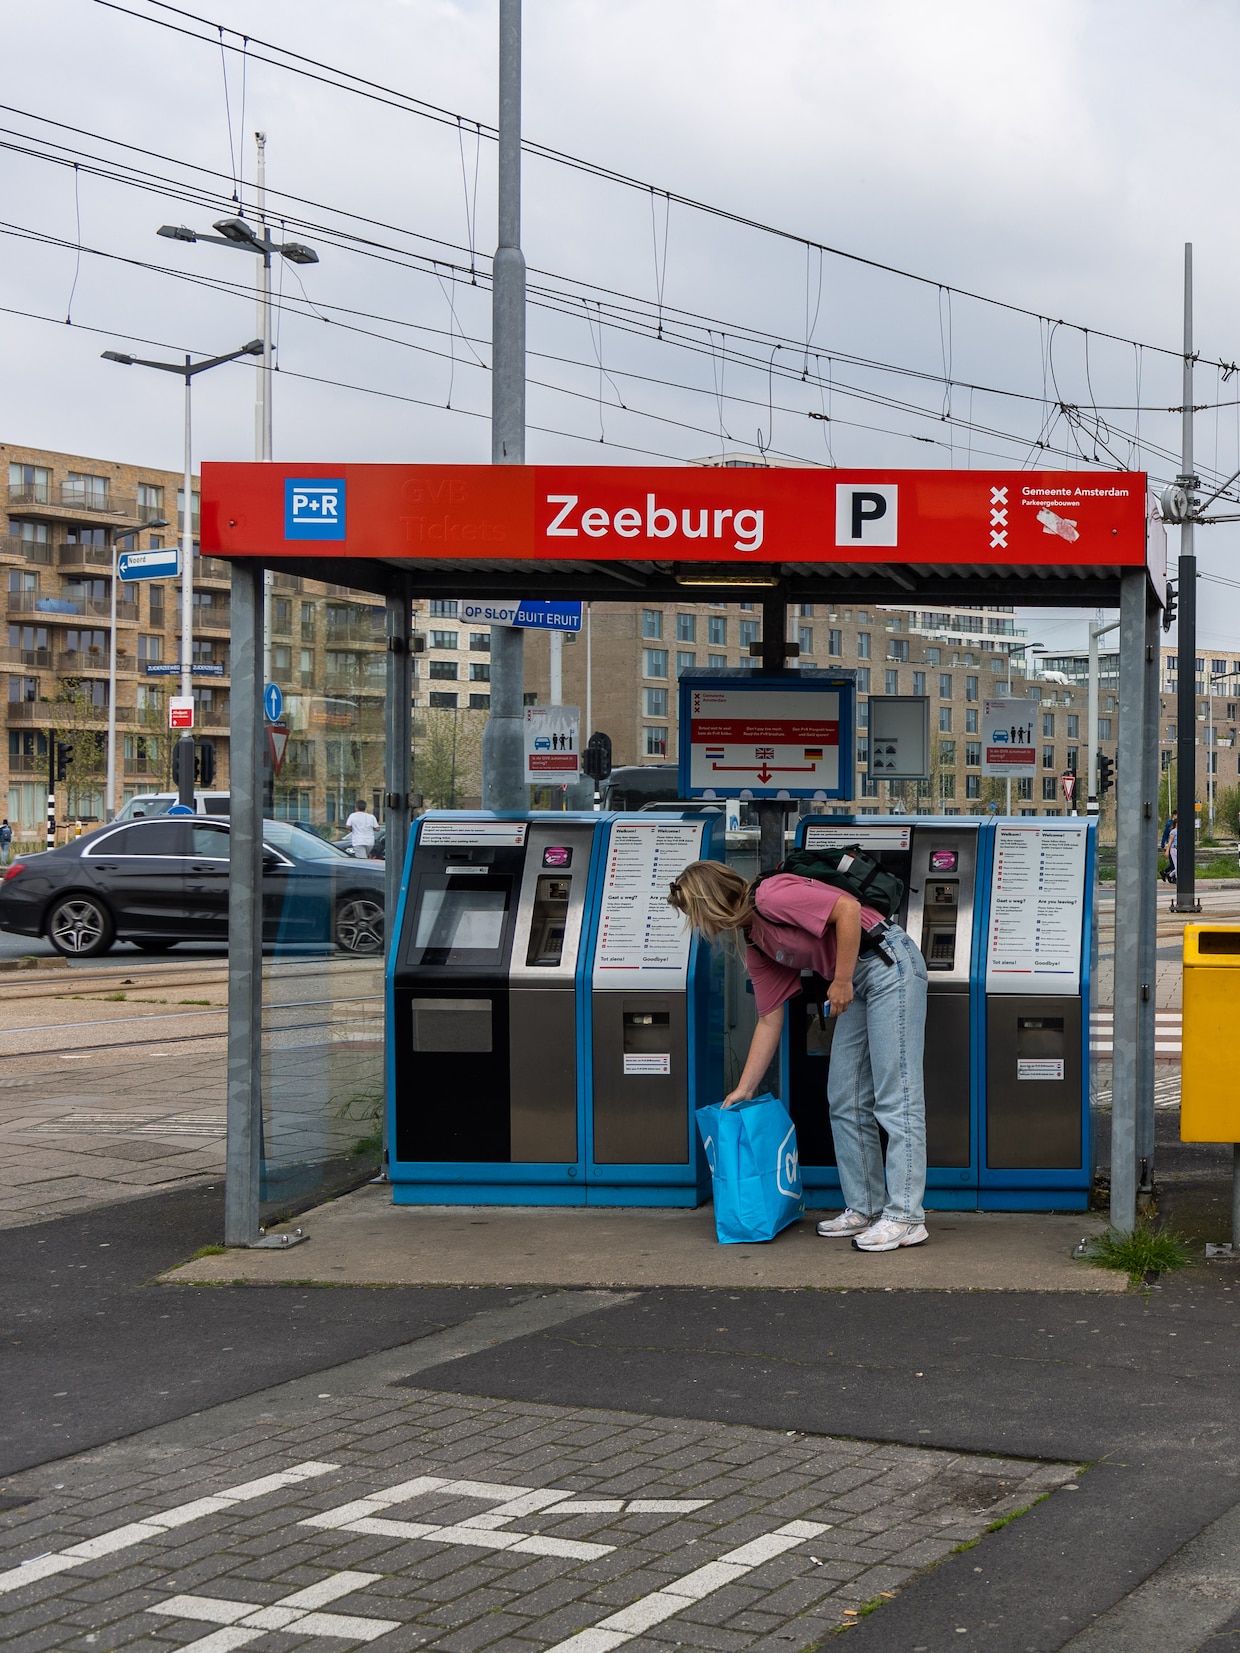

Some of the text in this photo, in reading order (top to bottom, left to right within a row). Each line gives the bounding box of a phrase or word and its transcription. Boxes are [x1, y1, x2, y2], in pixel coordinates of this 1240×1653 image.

[1022, 486, 1129, 497] Gemeente Amsterdam
[292, 494, 338, 516] P+R
[852, 492, 886, 538] P
[546, 493, 765, 551] Zeeburg
[129, 556, 146, 564] Noord
[465, 606, 579, 627] OP SLOT BUIT ERUIT
